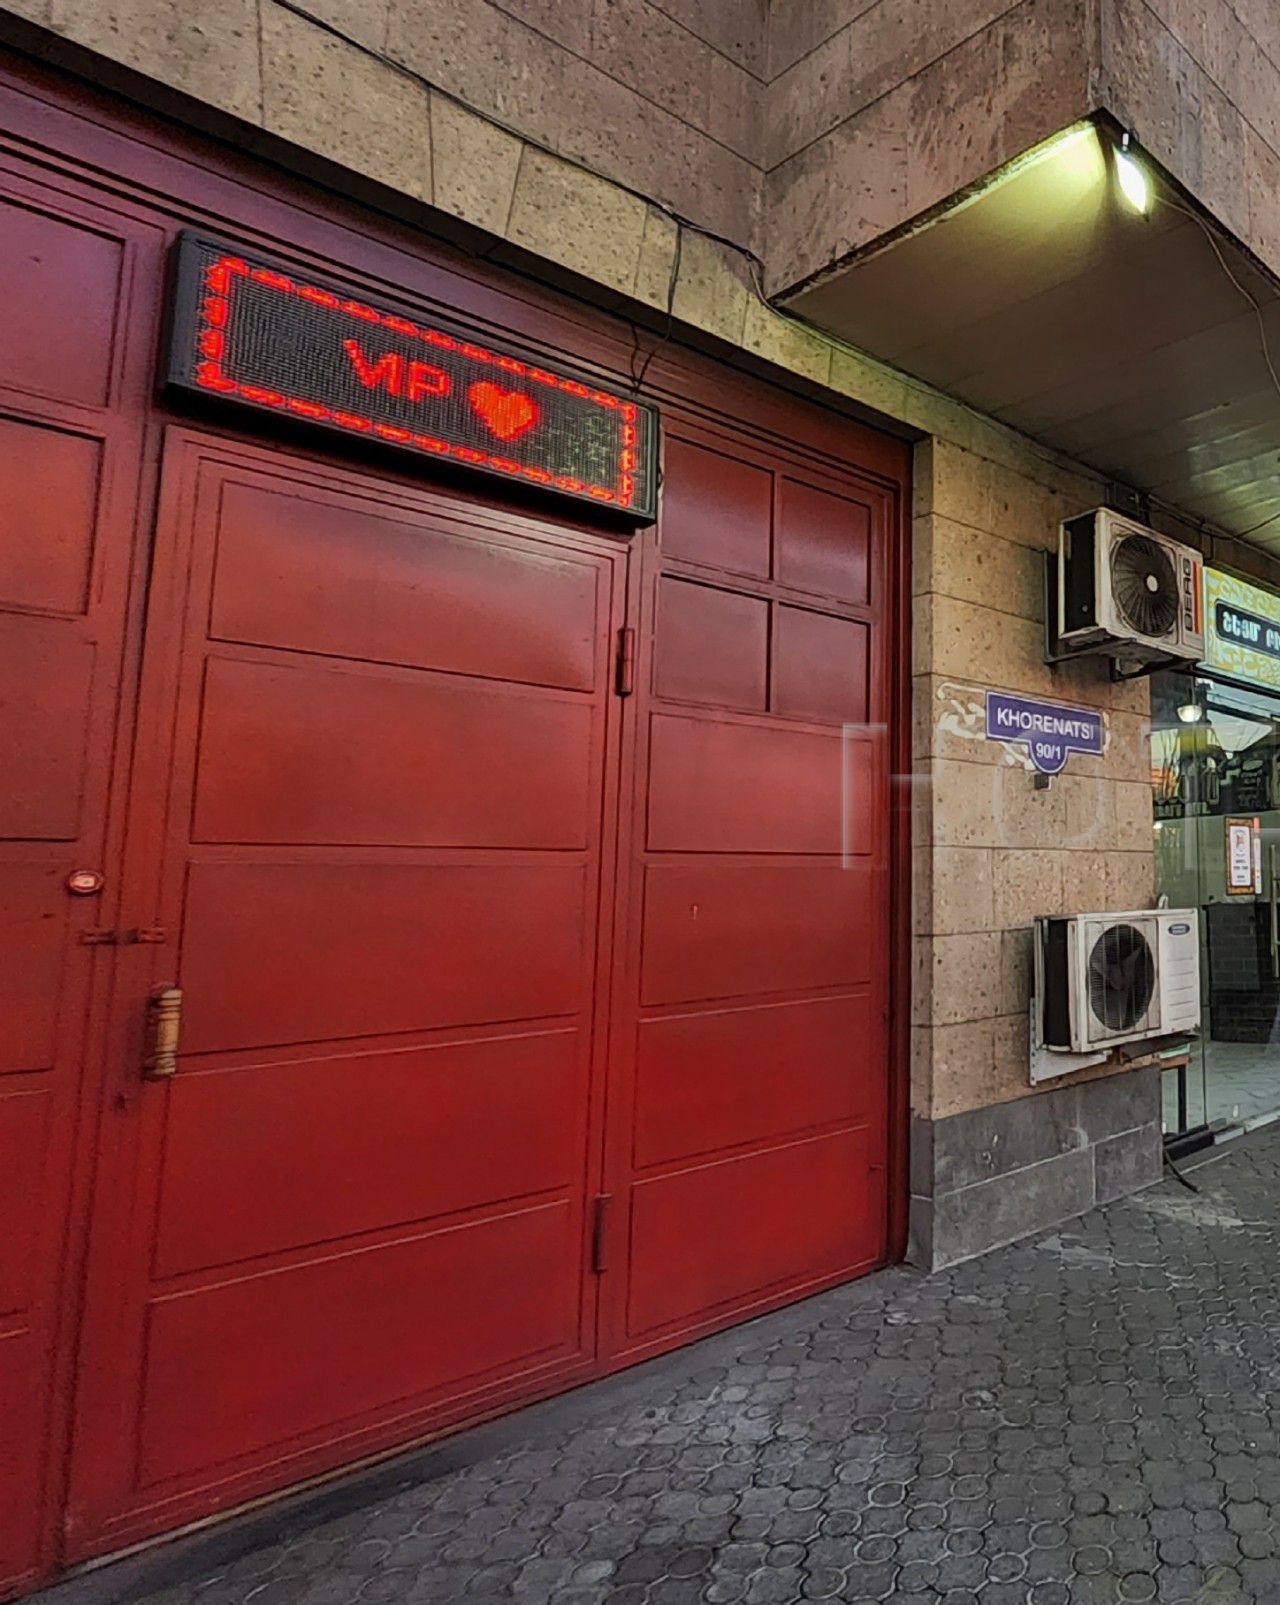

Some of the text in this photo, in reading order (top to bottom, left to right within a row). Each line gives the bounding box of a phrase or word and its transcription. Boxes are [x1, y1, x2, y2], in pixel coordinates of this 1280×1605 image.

[342, 338, 452, 402] VIP
[997, 707, 1094, 740] KHORENATSI
[1035, 742, 1061, 760] 90/1
